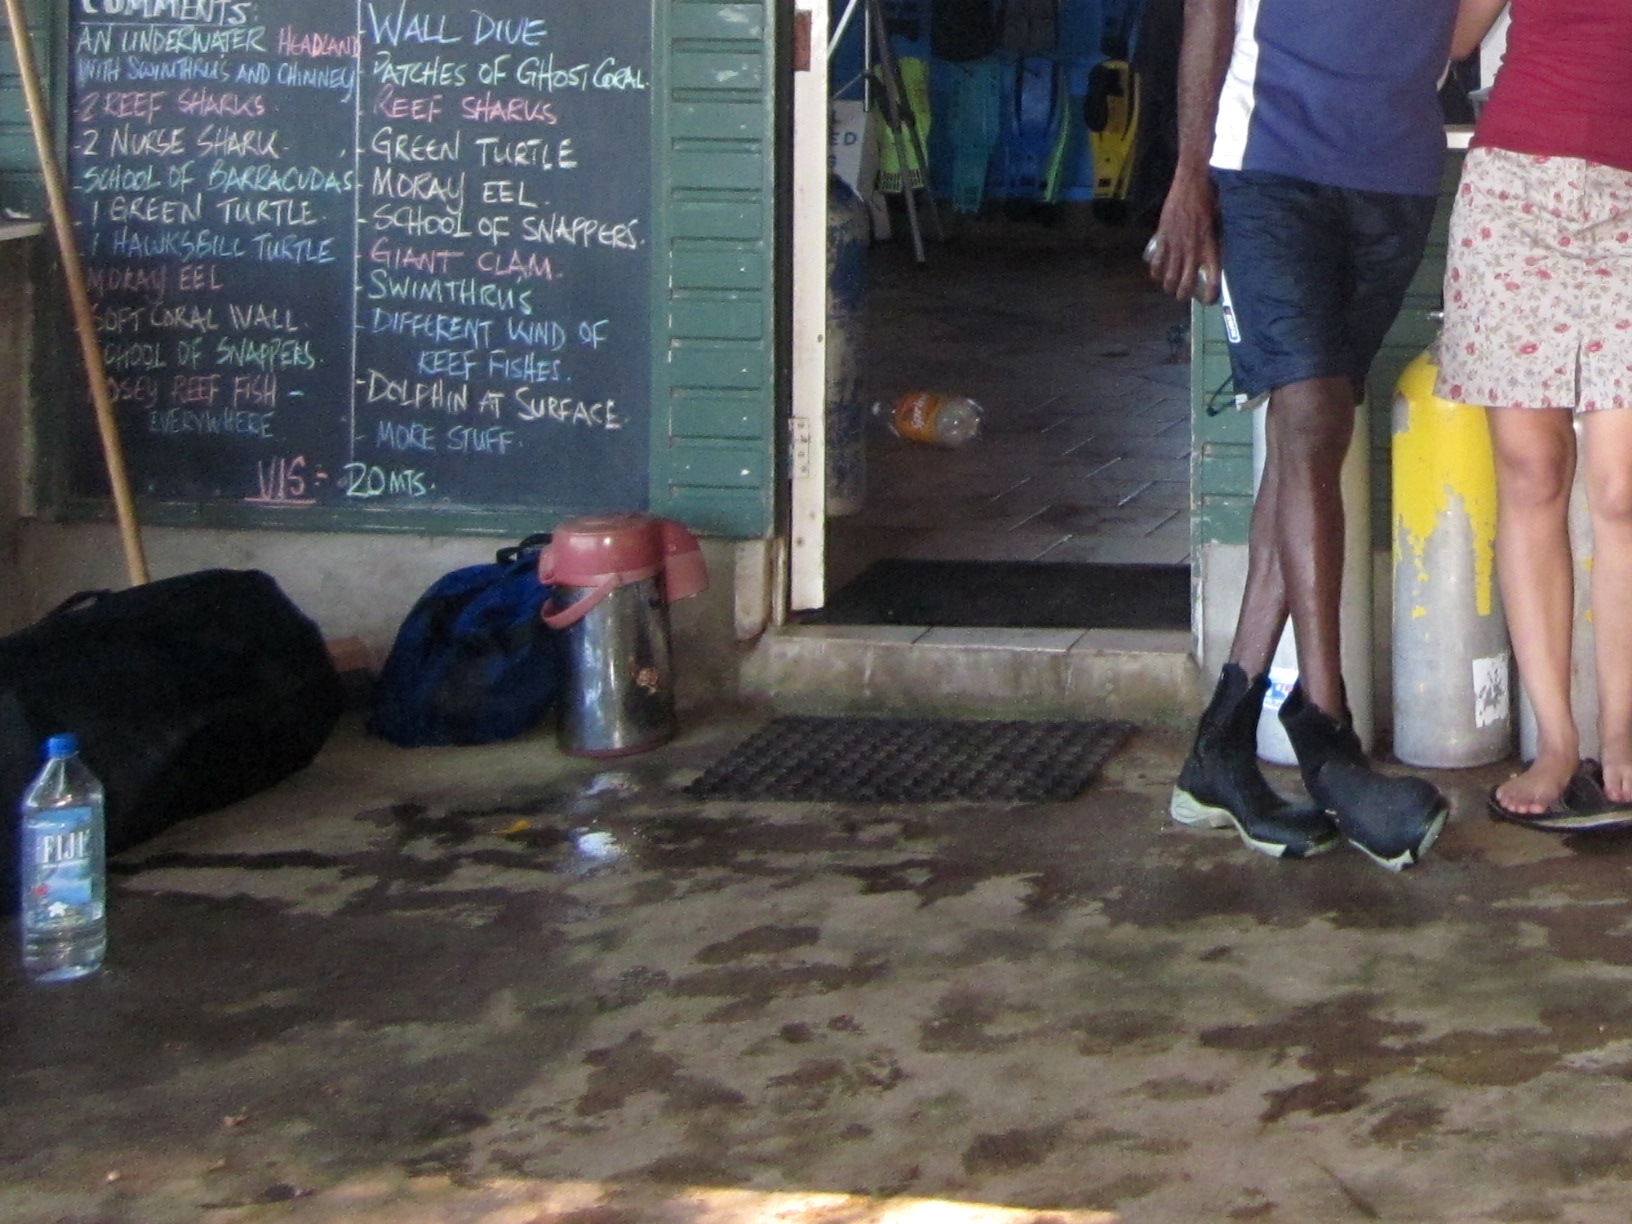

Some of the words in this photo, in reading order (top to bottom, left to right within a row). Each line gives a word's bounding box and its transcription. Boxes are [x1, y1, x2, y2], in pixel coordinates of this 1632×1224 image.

[77, 28, 113, 54] AN
[121, 26, 268, 55] UNDERWATER
[471, 9, 549, 47] DIVE
[236, 63, 271, 85] AND
[373, 51, 470, 87] PATCHES
[478, 54, 512, 86] OF
[104, 90, 168, 124] REEF
[178, 86, 266, 117] SHARKS
[374, 83, 444, 123] REEF
[462, 90, 557, 125] SHARKS
[110, 122, 186, 158] NURSE
[371, 126, 461, 164] GREEN
[474, 137, 578, 171] TURTLE
[168, 160, 196, 192] OF
[207, 159, 355, 194] BARRACUDAS
[372, 166, 465, 215] MORAY
[110, 193, 202, 224] GREEN
[372, 204, 473, 238] SCHOOL
[478, 214, 511, 246] OF
[113, 226, 248, 262] HAWKSBILL
[252, 233, 337, 264] TURTLE
[370, 236, 465, 274] GIANT
[179, 264, 225, 291] EEL
[579, 319, 610, 349] OF
[104, 342, 167, 371] CHOOL
[177, 337, 203, 370] OF
[418, 349, 479, 382] REEF
[367, 368, 468, 412] DOLPHIN
[478, 389, 506, 418] AT
[376, 419, 436, 452] MORE
[43, 830, 87, 864] FIJI
